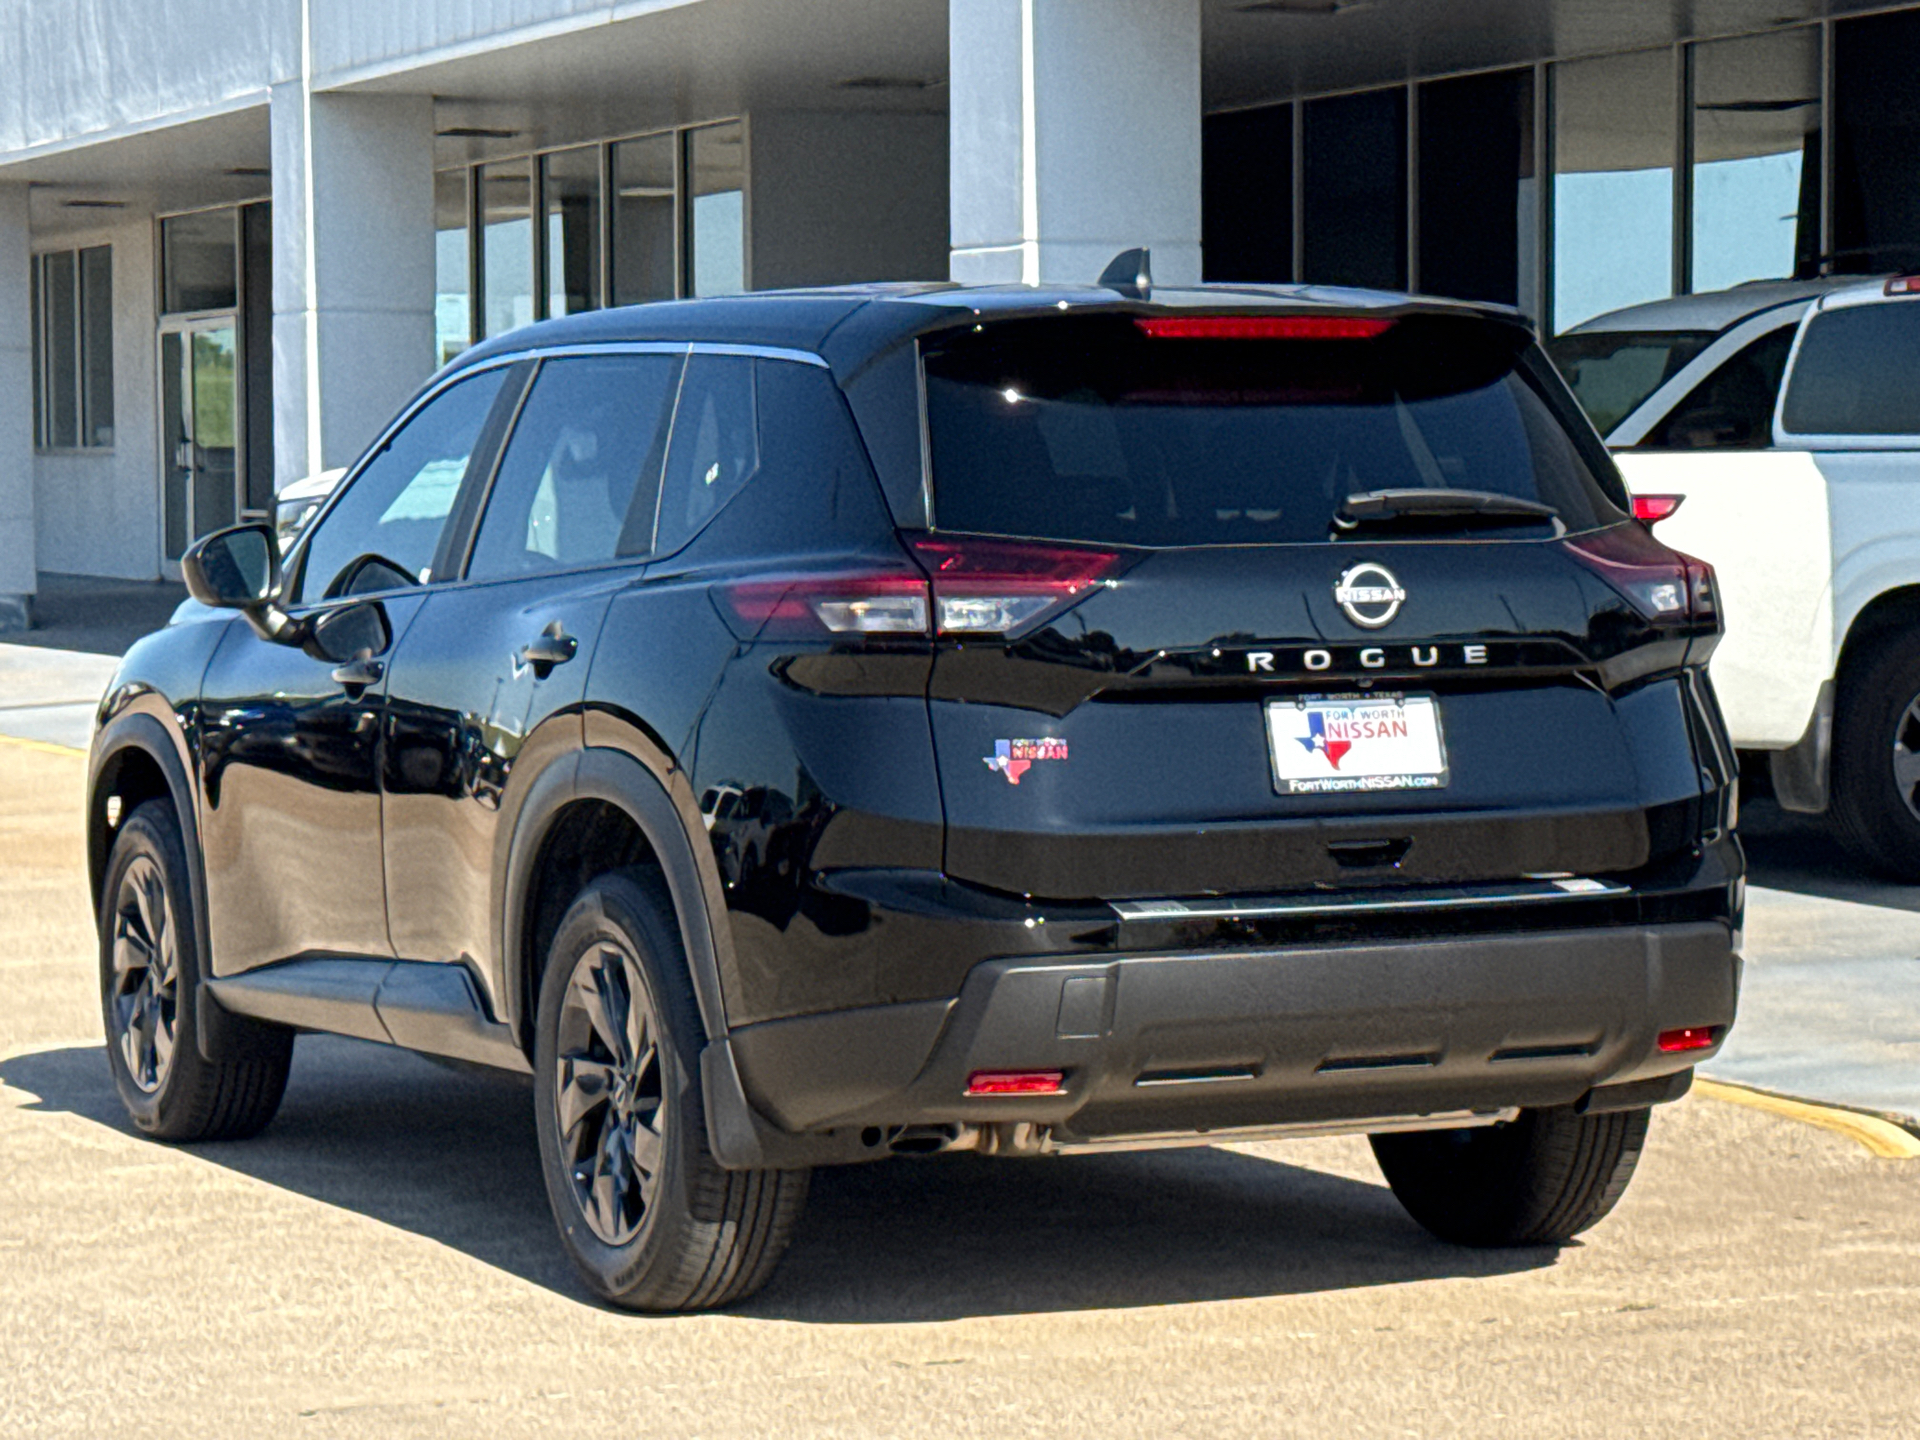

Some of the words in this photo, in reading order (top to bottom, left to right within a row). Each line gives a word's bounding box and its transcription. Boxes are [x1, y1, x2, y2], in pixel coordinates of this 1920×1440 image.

[1336, 587, 1406, 602] NISSAN
[1246, 645, 1488, 672] ROGUE
[1298, 693, 1323, 701] FORT
[1326, 692, 1361, 700] WORTH
[1373, 691, 1404, 699] TEXAS
[1326, 710, 1355, 720] FORT
[1360, 709, 1406, 720] WORTH
[1328, 720, 1408, 739] NISSAN
